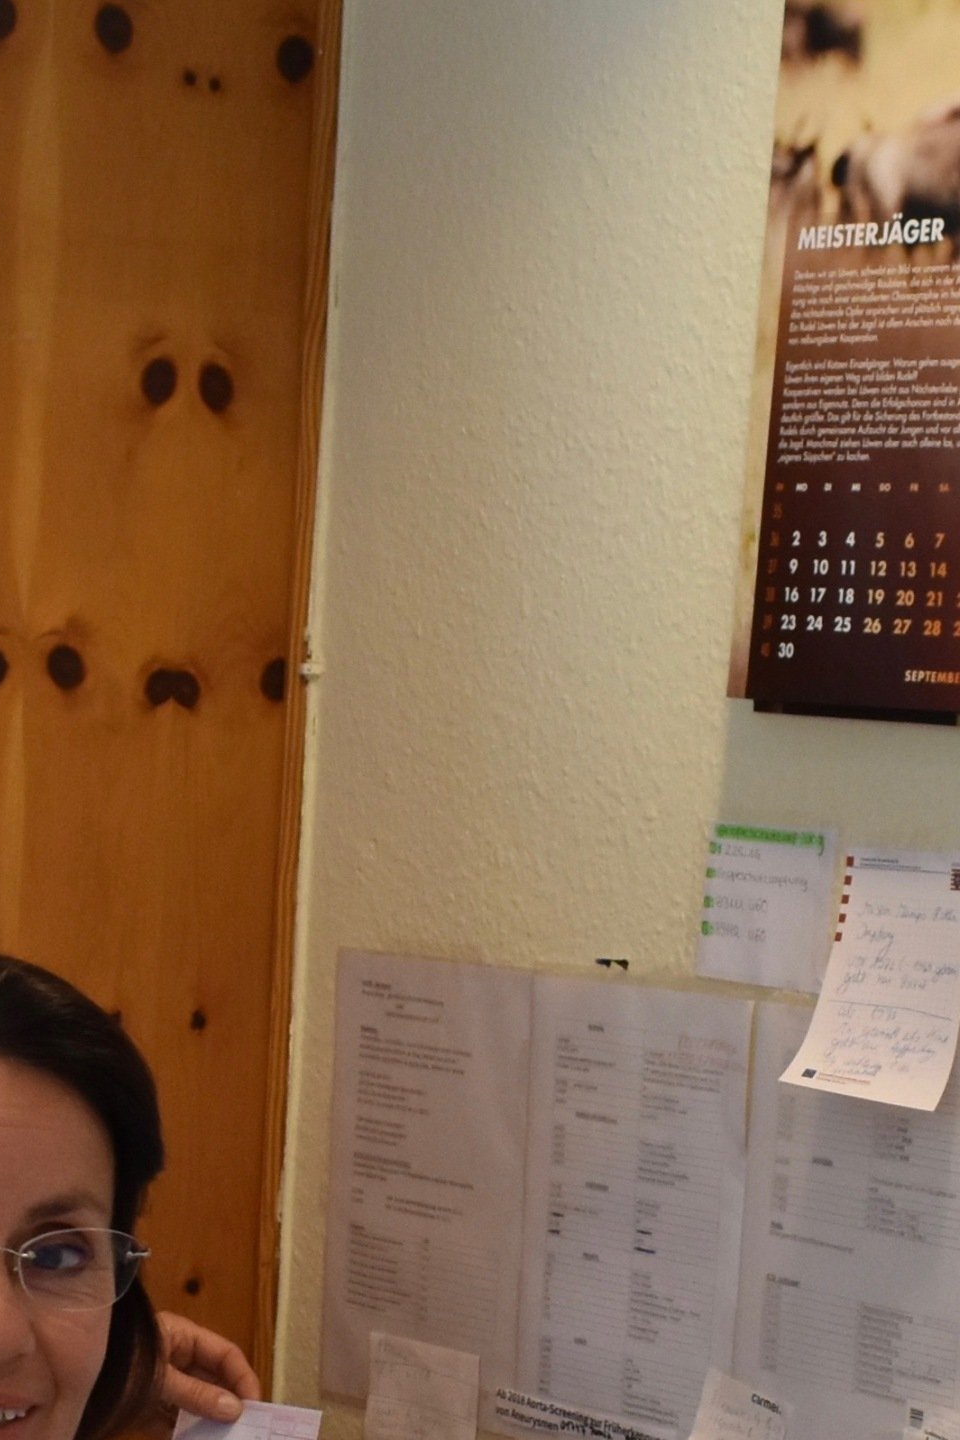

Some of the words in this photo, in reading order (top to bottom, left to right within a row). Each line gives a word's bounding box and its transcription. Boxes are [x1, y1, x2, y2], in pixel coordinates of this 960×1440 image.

[798, 213, 945, 250] MEISTERJÄGER
[792, 530, 801, 547] 2
[818, 530, 827, 547] 3
[846, 531, 856, 547] 4
[876, 532, 885, 548] 5
[905, 533, 915, 549] 6
[934, 533, 945, 549] 7
[789, 558, 798, 574] 9
[813, 559, 829, 575] 10
[841, 560, 856, 575] 11
[870, 561, 887, 576] 12
[900, 561, 917, 578] 13
[930, 562, 947, 578] 14
[784, 587, 799, 602] 16
[810, 588, 826, 602] 17
[838, 588, 855, 605] 18
[868, 589, 885, 605] 19
[896, 590, 915, 607] 20
[926, 591, 944, 607] 21
[781, 615, 797, 631] 23
[806, 615, 823, 631] 24
[834, 616, 851, 633] 25
[863, 617, 882, 634] 26
[893, 619, 912, 635] 27
[923, 619, 941, 636] 28
[953, 620, 960, 637] 2
[778, 642, 794, 658] 30
[496, 1389, 507, 1400] Ab
[508, 1391, 525, 1406] 2018
[526, 1396, 589, 1427] Aorta-Screening
[495, 1406, 511, 1417] von
[511, 1408, 560, 1433] Aneurysmen
